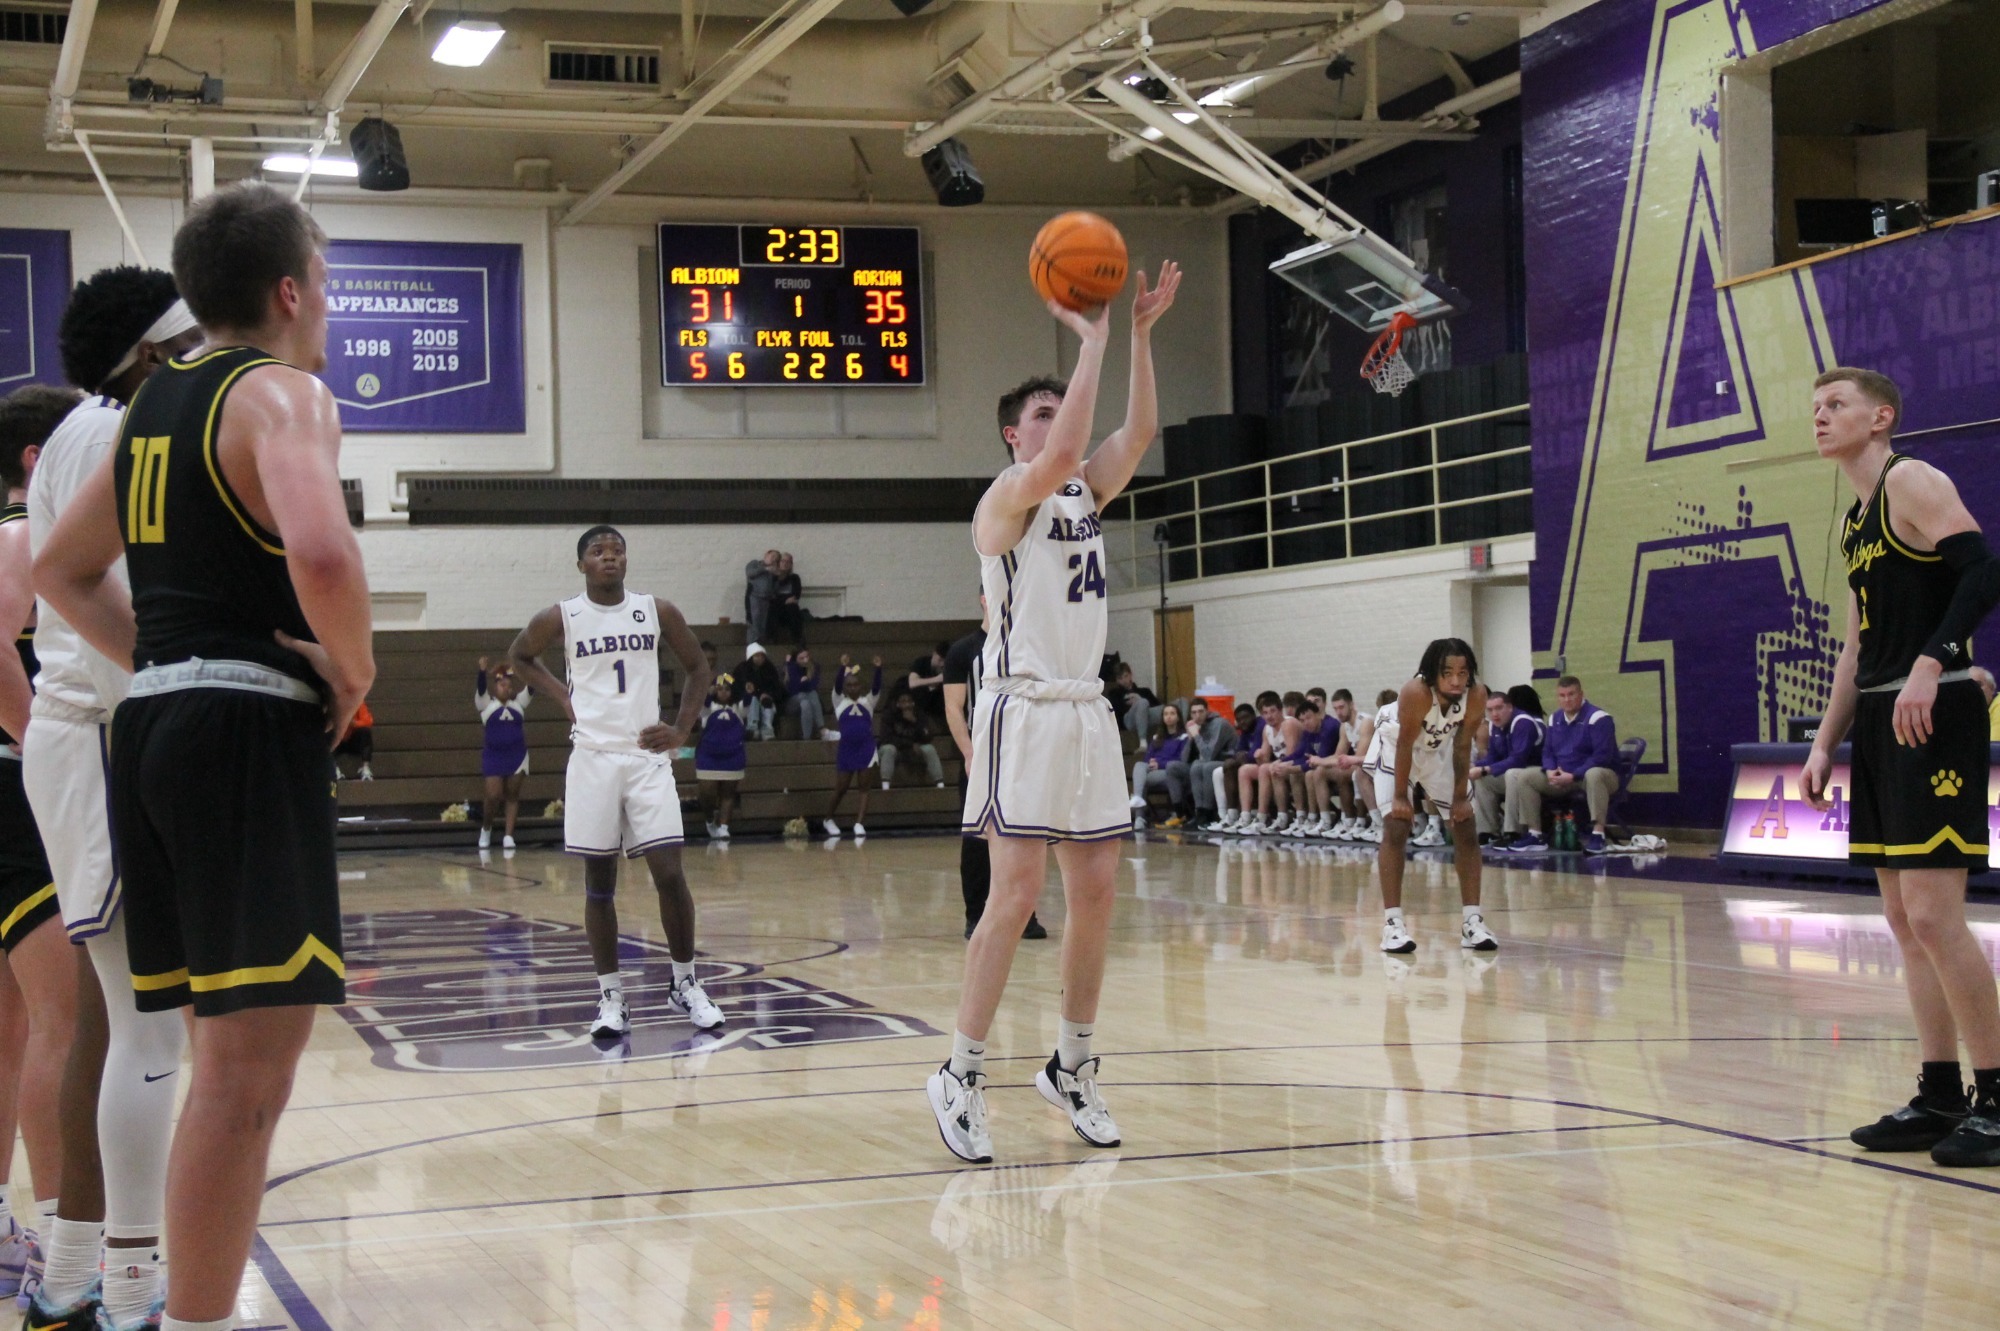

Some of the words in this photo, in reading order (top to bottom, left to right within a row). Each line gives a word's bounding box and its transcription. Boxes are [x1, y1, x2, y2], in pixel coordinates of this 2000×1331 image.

[767, 228, 839, 263] 2:33
[345, 280, 435, 292] BASKETBALL
[671, 267, 740, 285] ALBION
[775, 278, 811, 290] PERIOD
[853, 269, 902, 287] ADRIAN
[327, 295, 459, 314] APPEARANCES
[795, 294, 803, 318] 1
[865, 290, 907, 324] 35
[344, 339, 391, 357] 1998
[412, 328, 459, 346] 2005
[680, 330, 708, 348] FLS
[757, 330, 792, 348] PLYR
[800, 330, 834, 348] FOUL
[881, 331, 908, 348] FLS
[412, 354, 460, 371] 2019
[690, 352, 708, 379] 5
[728, 352, 745, 379] 6
[846, 353, 863, 379] 6
[890, 354, 909, 378] 4
[128, 435, 171, 544] 10
[1068, 550, 1106, 603] 24
[575, 634, 655, 658] ALBION
[613, 659, 626, 694] 1
[1749, 774, 1790, 839] A
